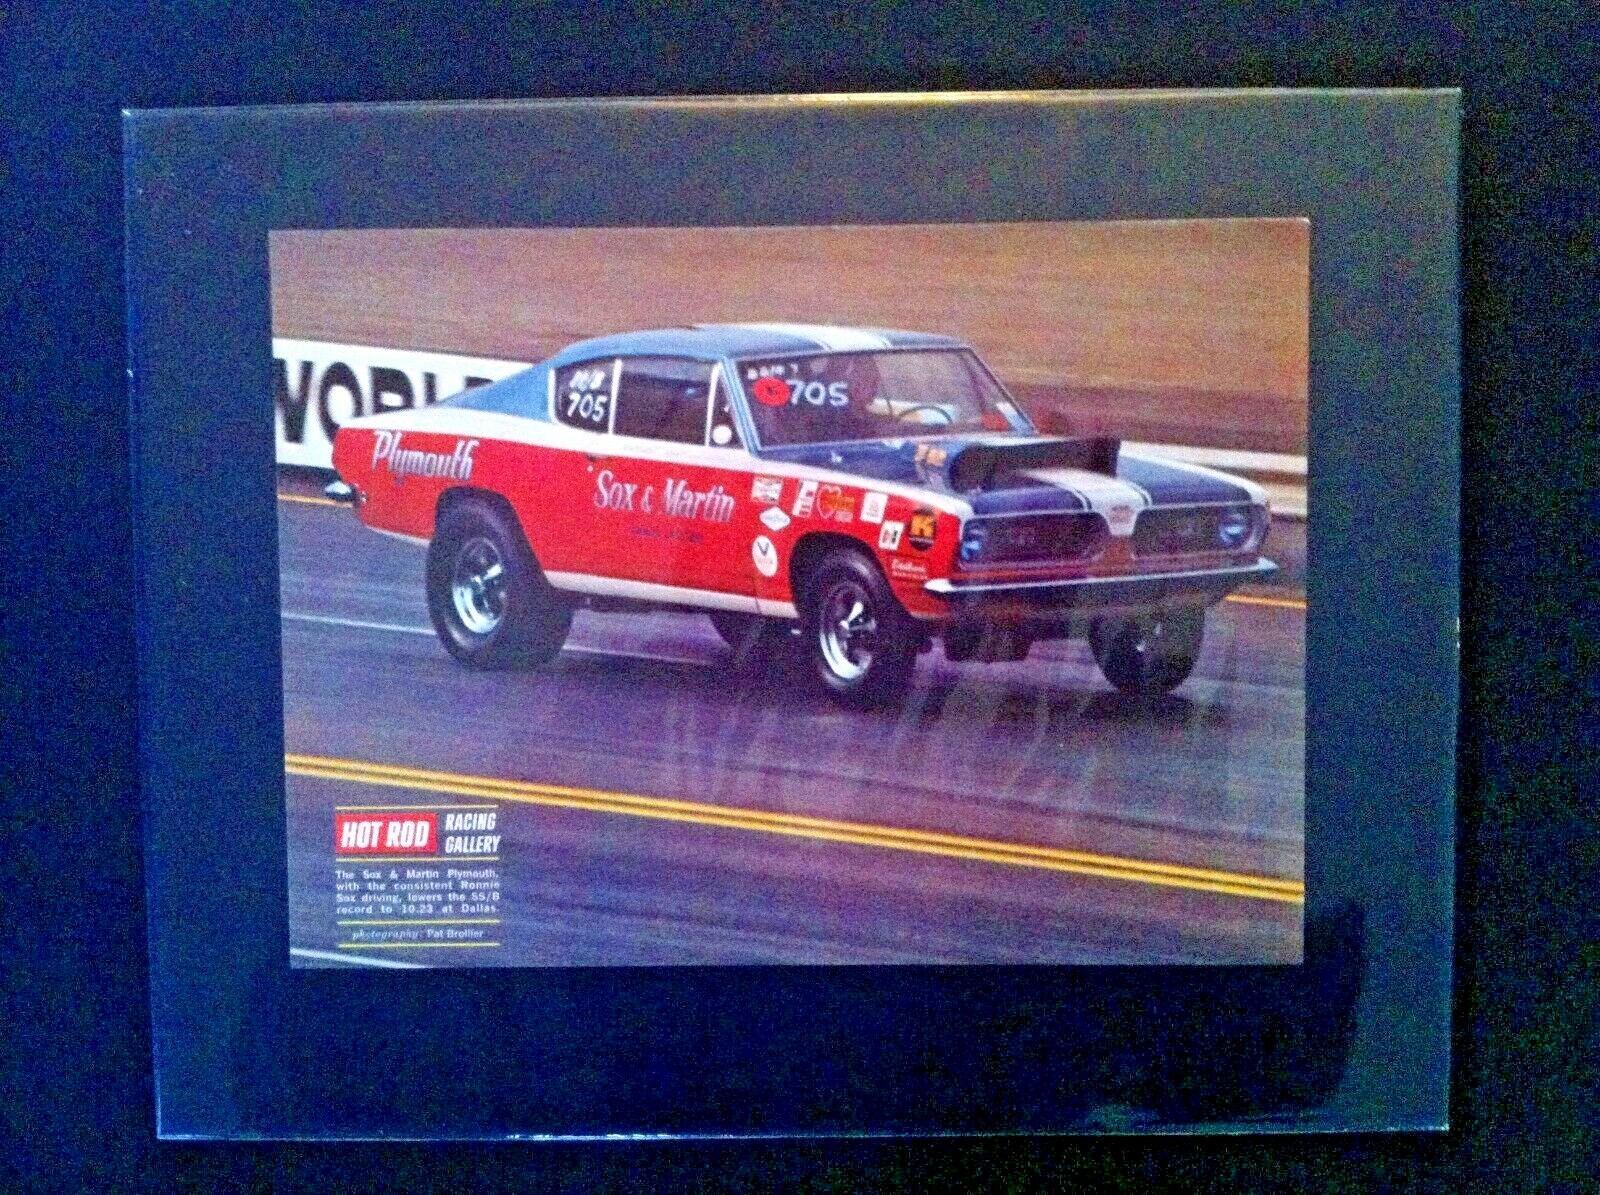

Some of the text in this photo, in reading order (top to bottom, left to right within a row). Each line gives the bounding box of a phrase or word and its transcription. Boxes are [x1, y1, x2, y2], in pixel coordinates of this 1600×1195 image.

[785, 379, 850, 407] 705
[567, 392, 608, 422] 705
[371, 429, 480, 482] Plymouth
[593, 469, 638, 512] Sox
[663, 477, 736, 523] Martin
[445, 812, 498, 831] RACING
[341, 820, 430, 849] HOT ROD
[445, 835, 501, 854] GALLERY
[335, 869, 355, 879] The
[362, 869, 382, 879] Sox
[389, 869, 399, 879] &
[406, 868, 439, 879] Martin
[336, 880, 500, 891] with the consistent Ronnie
[336, 893, 356, 903] Sox
[408, 892, 443, 902] lowers
[447, 891, 466, 902] the
[336, 904, 373, 914] record
[381, 904, 393, 914] to
[402, 904, 433, 914] 10.23
[441, 903, 453, 913] at
[427, 928, 444, 938] Pat
